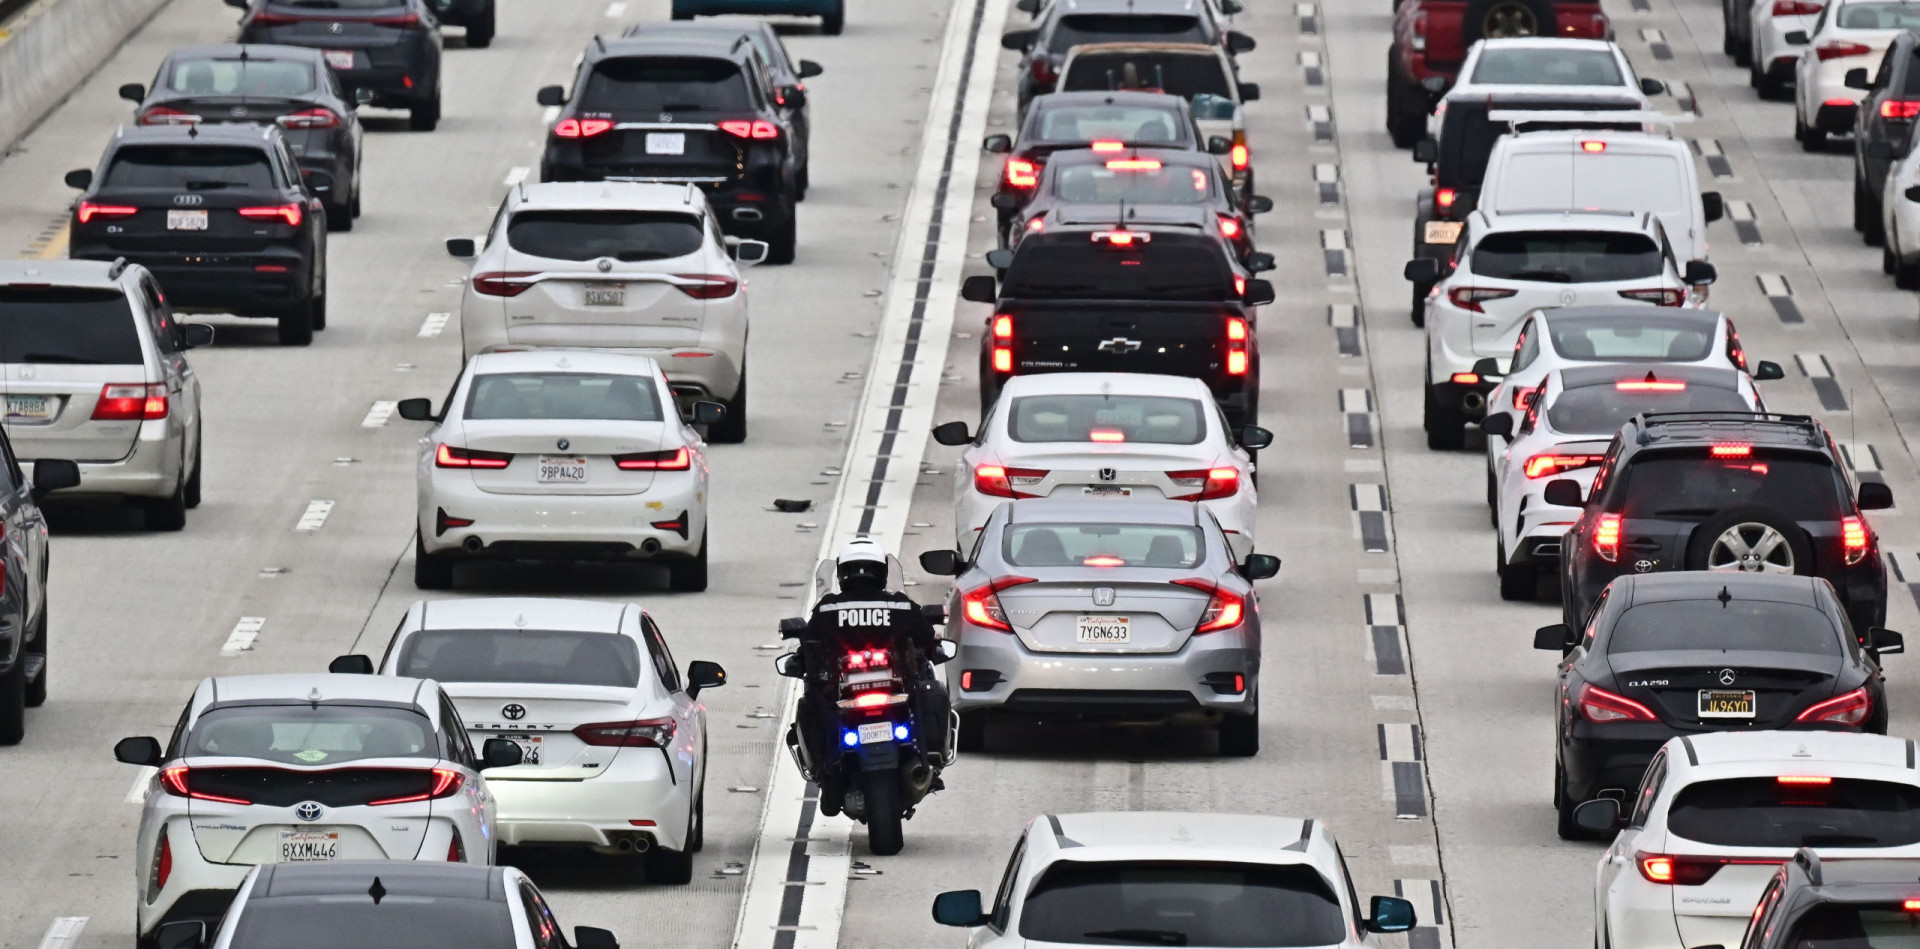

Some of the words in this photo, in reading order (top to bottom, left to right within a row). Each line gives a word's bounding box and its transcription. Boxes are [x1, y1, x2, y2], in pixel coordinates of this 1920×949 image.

[541, 466, 585, 480] 9BPA420
[838, 609, 891, 627] POLICE
[1080, 626, 1127, 639] 7YGN633
[291, 832, 327, 842] California
[282, 842, 336, 857] 8XXM446
